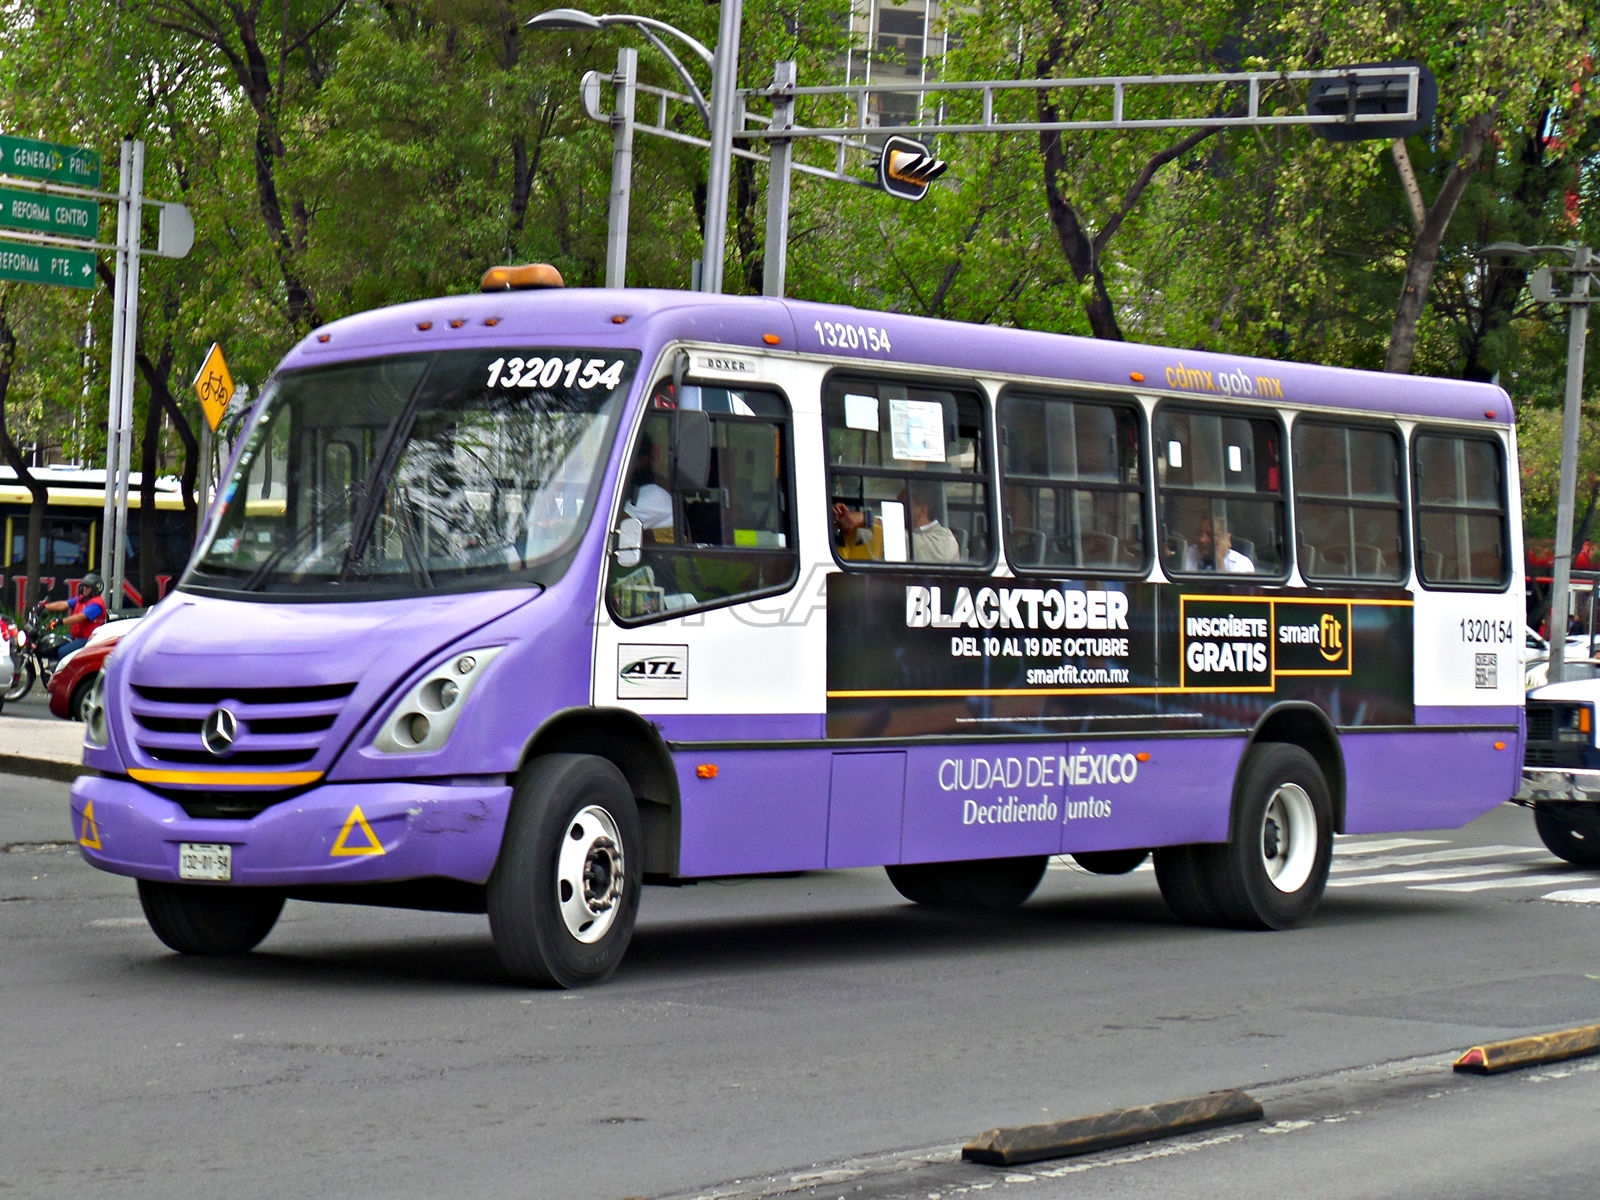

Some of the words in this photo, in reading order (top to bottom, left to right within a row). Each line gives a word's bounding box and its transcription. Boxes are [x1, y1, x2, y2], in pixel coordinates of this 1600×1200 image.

[12, 200, 50, 222] REFORMA
[55, 206, 89, 228] CENTRO
[51, 257, 73, 277] PTE.
[814, 320, 892, 353] 1320154
[486, 357, 625, 391] 1320154
[707, 358, 746, 371] BOXER
[1165, 361, 1285, 398] cdmx.gob.mx
[906, 585, 1130, 630] BLACKTOBER
[1460, 618, 1513, 643] 1320154
[951, 636, 982, 656] DEL
[984, 637, 1000, 656] 10
[1002, 637, 1023, 656] AL
[1024, 637, 1040, 656] 19
[1042, 637, 1063, 656] DE
[1064, 638, 1130, 657] OCTUBRE
[1186, 641, 1268, 673] GRATIS
[625, 661, 682, 675] ATL
[1026, 664, 1130, 685] smartfit.com.mx
[938, 757, 1023, 791] CIUDAD
[1026, 756, 1055, 787] DE
[963, 795, 1058, 825] Decidiendo
